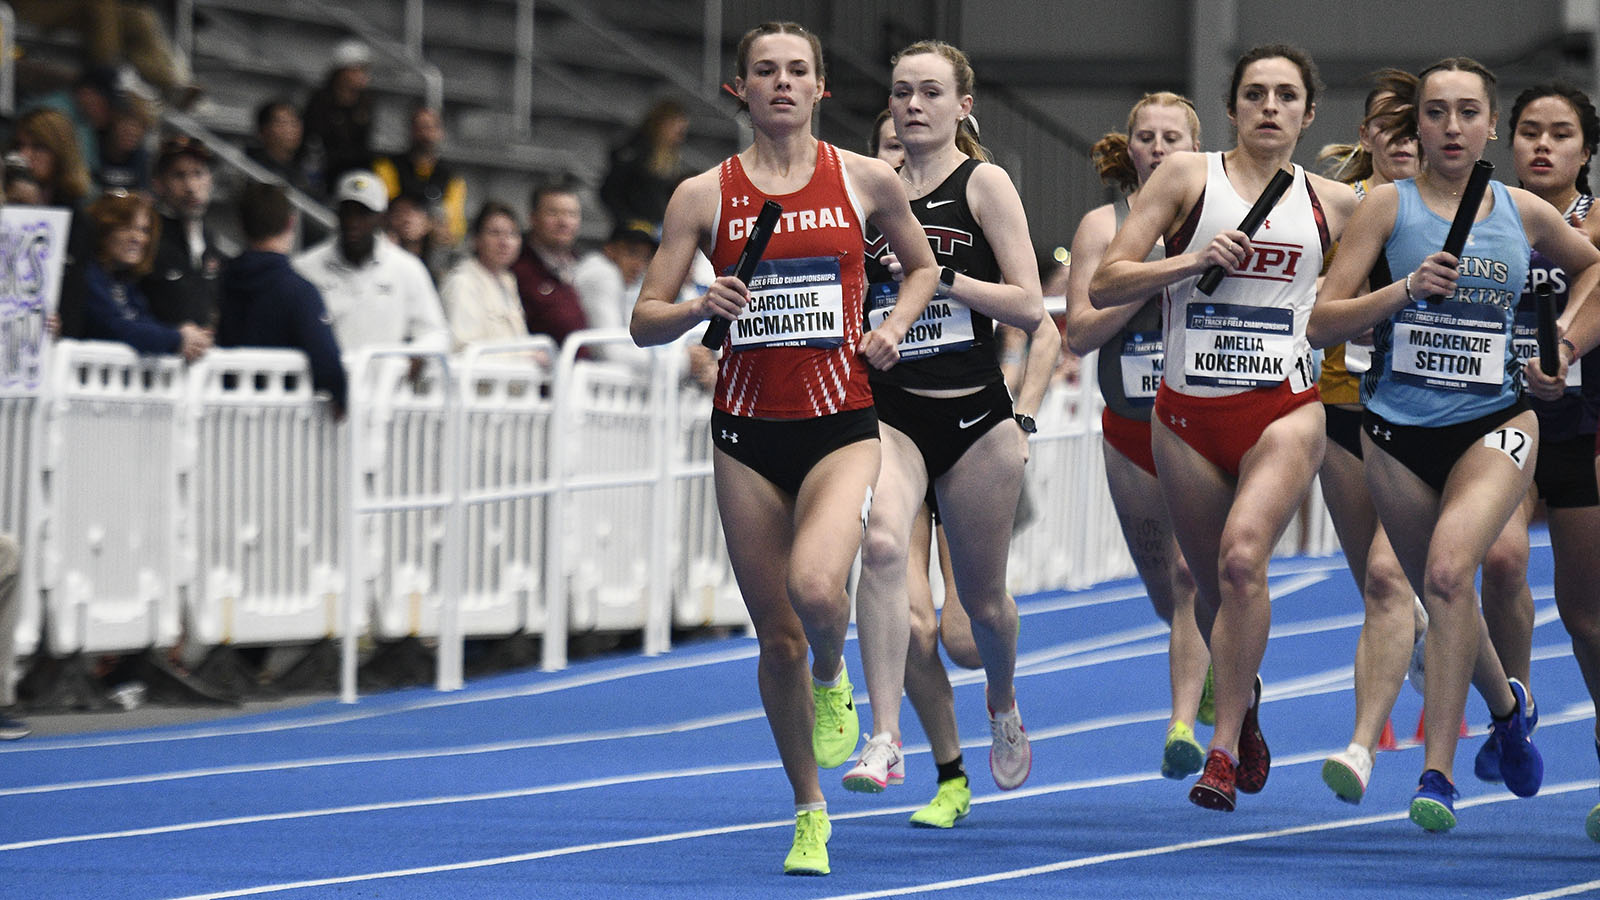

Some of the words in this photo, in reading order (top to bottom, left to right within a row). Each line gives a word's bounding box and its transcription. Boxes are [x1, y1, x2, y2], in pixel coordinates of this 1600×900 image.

[767, 277, 784, 285] FIELD
[784, 273, 836, 284] CHAMPIONSHIPS
[1456, 256, 1509, 284] HNS
[748, 292, 820, 313] CAROLINE
[737, 311, 835, 339] MCMARTIN
[897, 322, 942, 345] ROW
[1227, 319, 1243, 328] FIELD
[1243, 320, 1290, 331] CHAMPIONSHIPS
[1440, 316, 1457, 325] FIELD
[1457, 318, 1503, 330] CHAMPIONSHIPS
[1214, 334, 1265, 352] AMELIA
[1409, 329, 1492, 353] MACKENZIE
[1194, 352, 1284, 375] KOKERNAK
[1415, 350, 1482, 376] SETTON
[1495, 429, 1526, 464] 12
